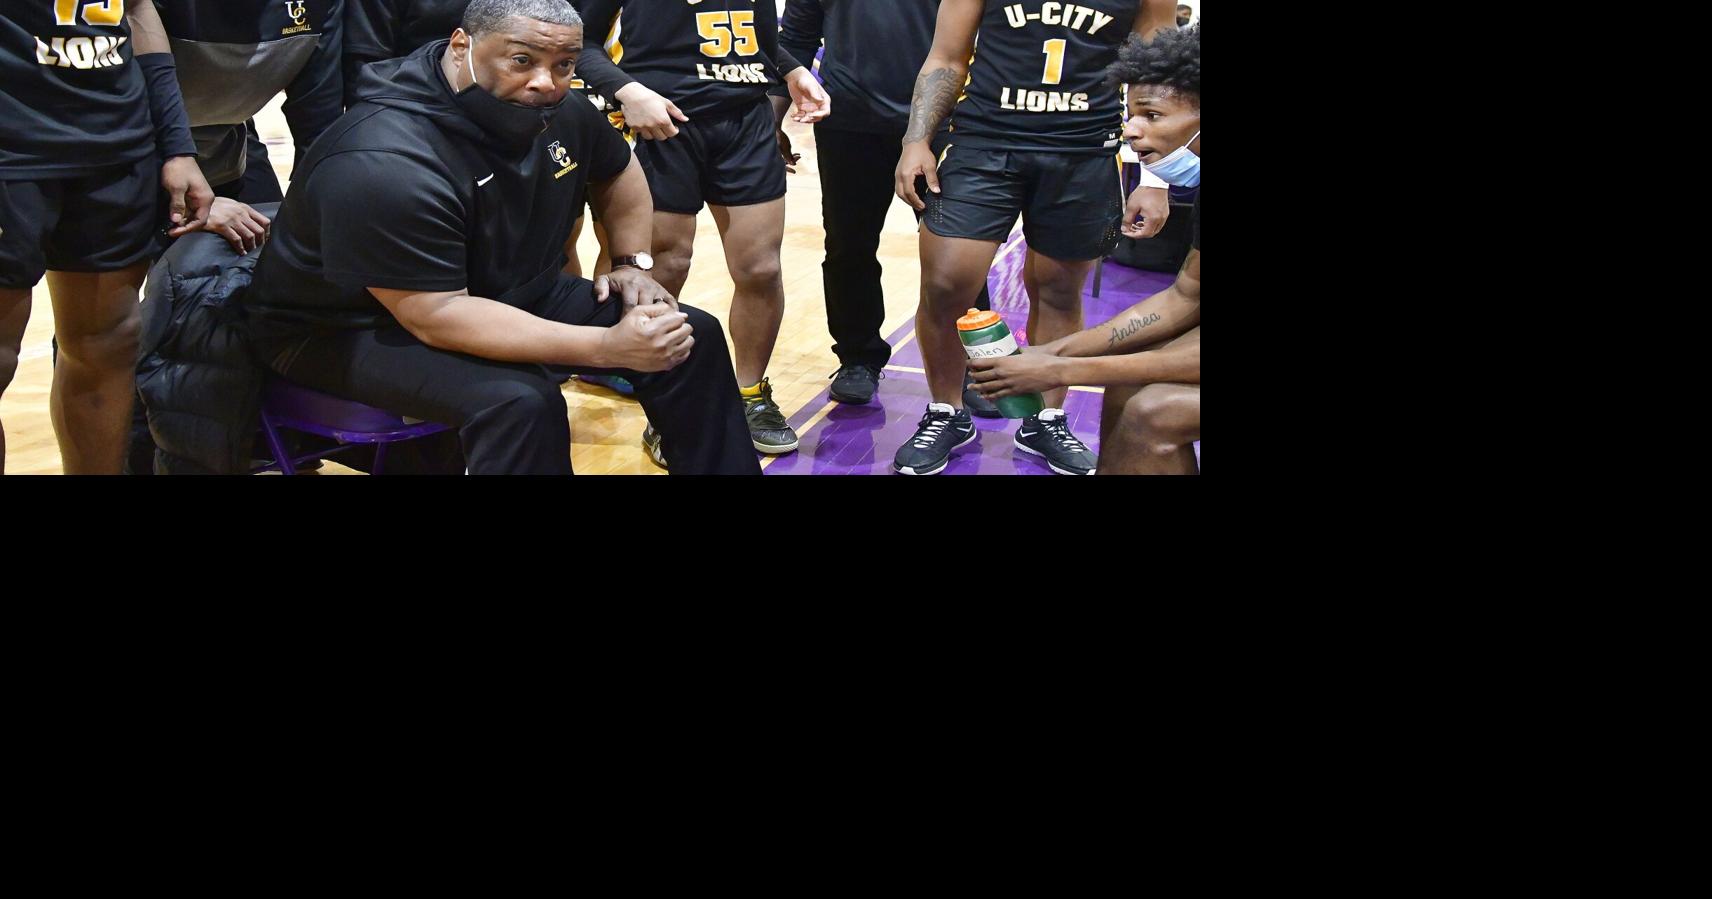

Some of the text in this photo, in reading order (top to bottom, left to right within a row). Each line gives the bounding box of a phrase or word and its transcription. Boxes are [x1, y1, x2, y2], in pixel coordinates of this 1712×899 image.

[695, 10, 760, 57] 55
[1003, 1, 1114, 35] U-CITY
[1041, 38, 1067, 85] 1
[1000, 86, 1090, 112] LIONS
[1107, 312, 1161, 348] Andrea
